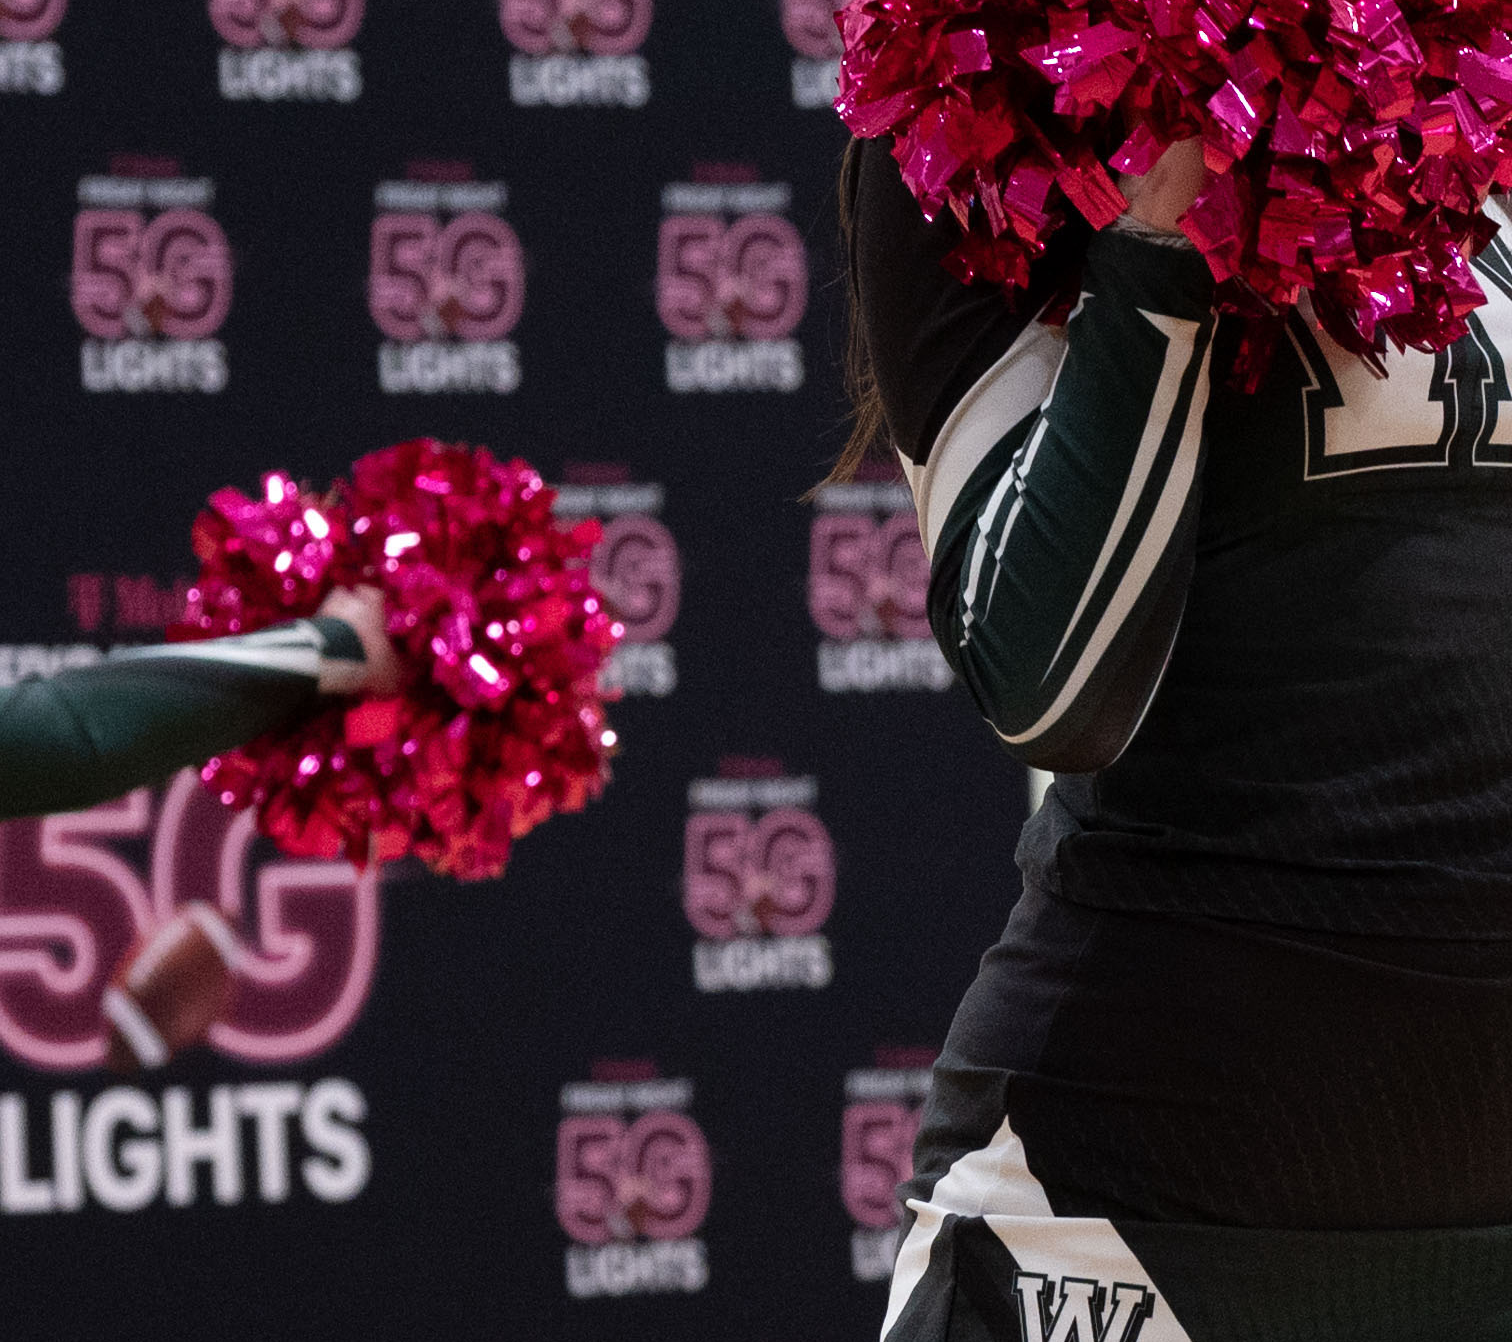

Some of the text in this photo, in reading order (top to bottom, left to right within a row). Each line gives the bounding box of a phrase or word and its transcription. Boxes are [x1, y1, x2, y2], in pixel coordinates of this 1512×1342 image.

[218, 48, 362, 102] LIGHTS
[510, 53, 650, 107] LIGHTS
[72, 210, 231, 338] 5G
[369, 213, 523, 341] 5G
[658, 215, 806, 340] 5G
[81, 340, 227, 393] LIGHTS
[379, 341, 521, 394] LIGHTS
[666, 339, 804, 393] LIGHTS
[685, 809, 834, 938] 5G
[694, 936, 832, 992] LIGHTS
[557, 1112, 710, 1243] 5G
[566, 1239, 708, 1298] LIGHTS
